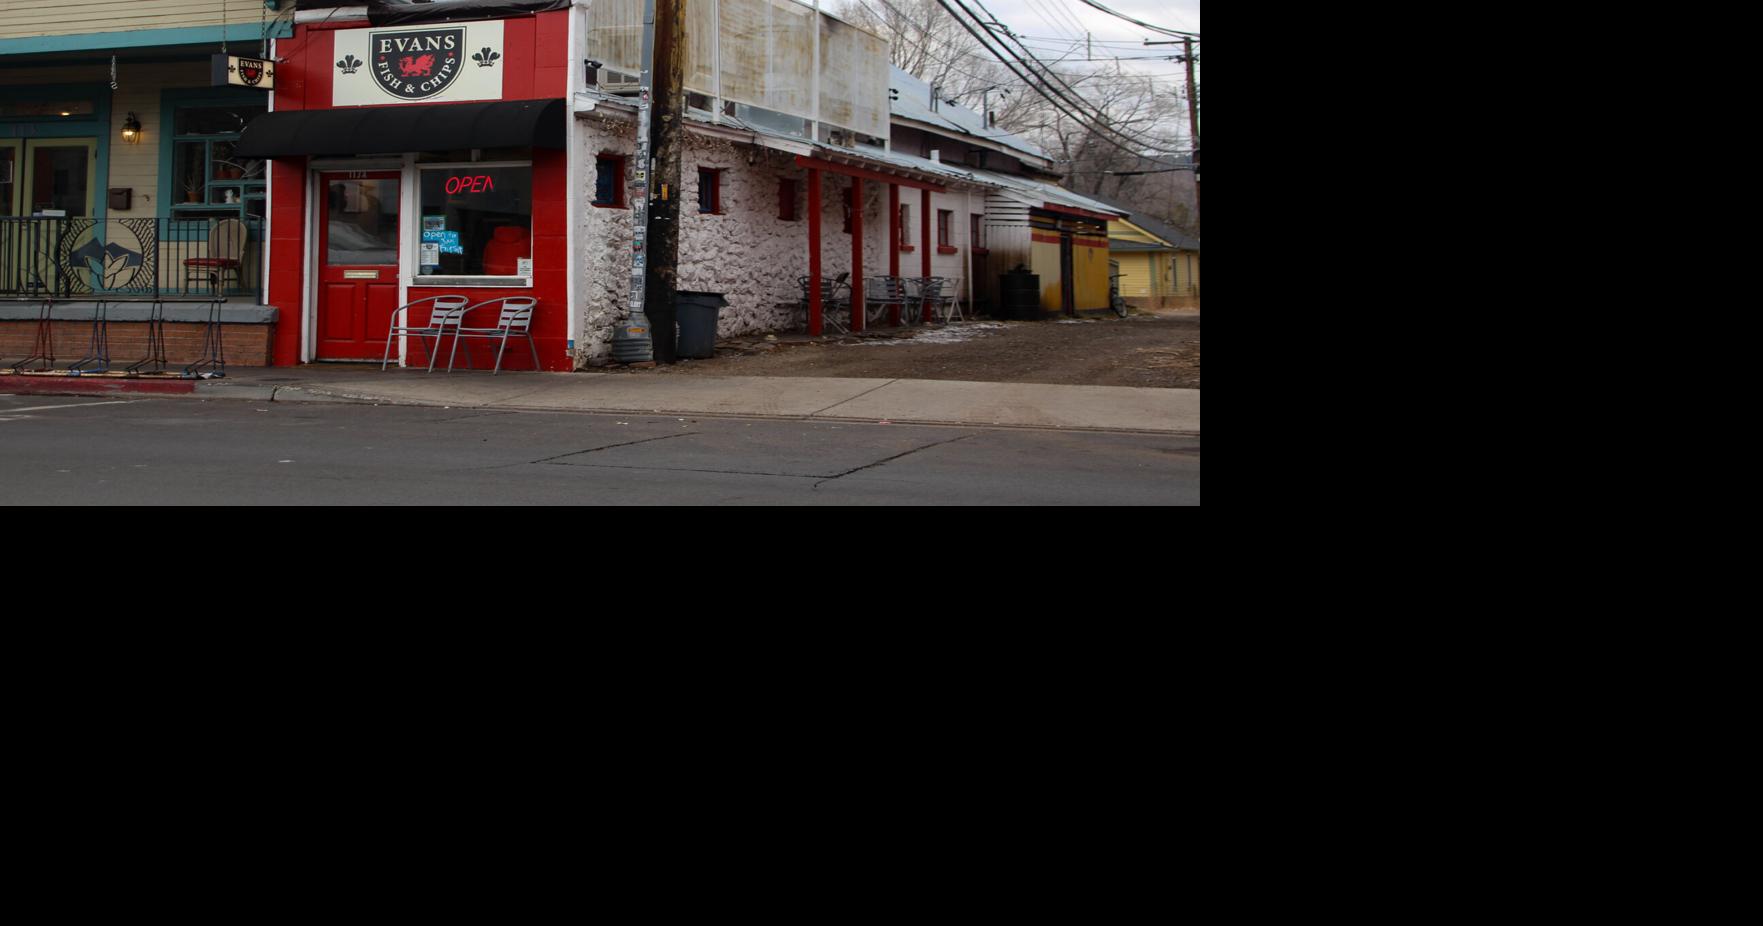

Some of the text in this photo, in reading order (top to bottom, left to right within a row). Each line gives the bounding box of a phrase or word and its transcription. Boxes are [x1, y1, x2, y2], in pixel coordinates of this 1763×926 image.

[379, 34, 455, 54] EVANS
[240, 60, 262, 69] EVANS
[378, 57, 456, 93] FISH & CHIPS
[445, 175, 494, 194] OPEN
